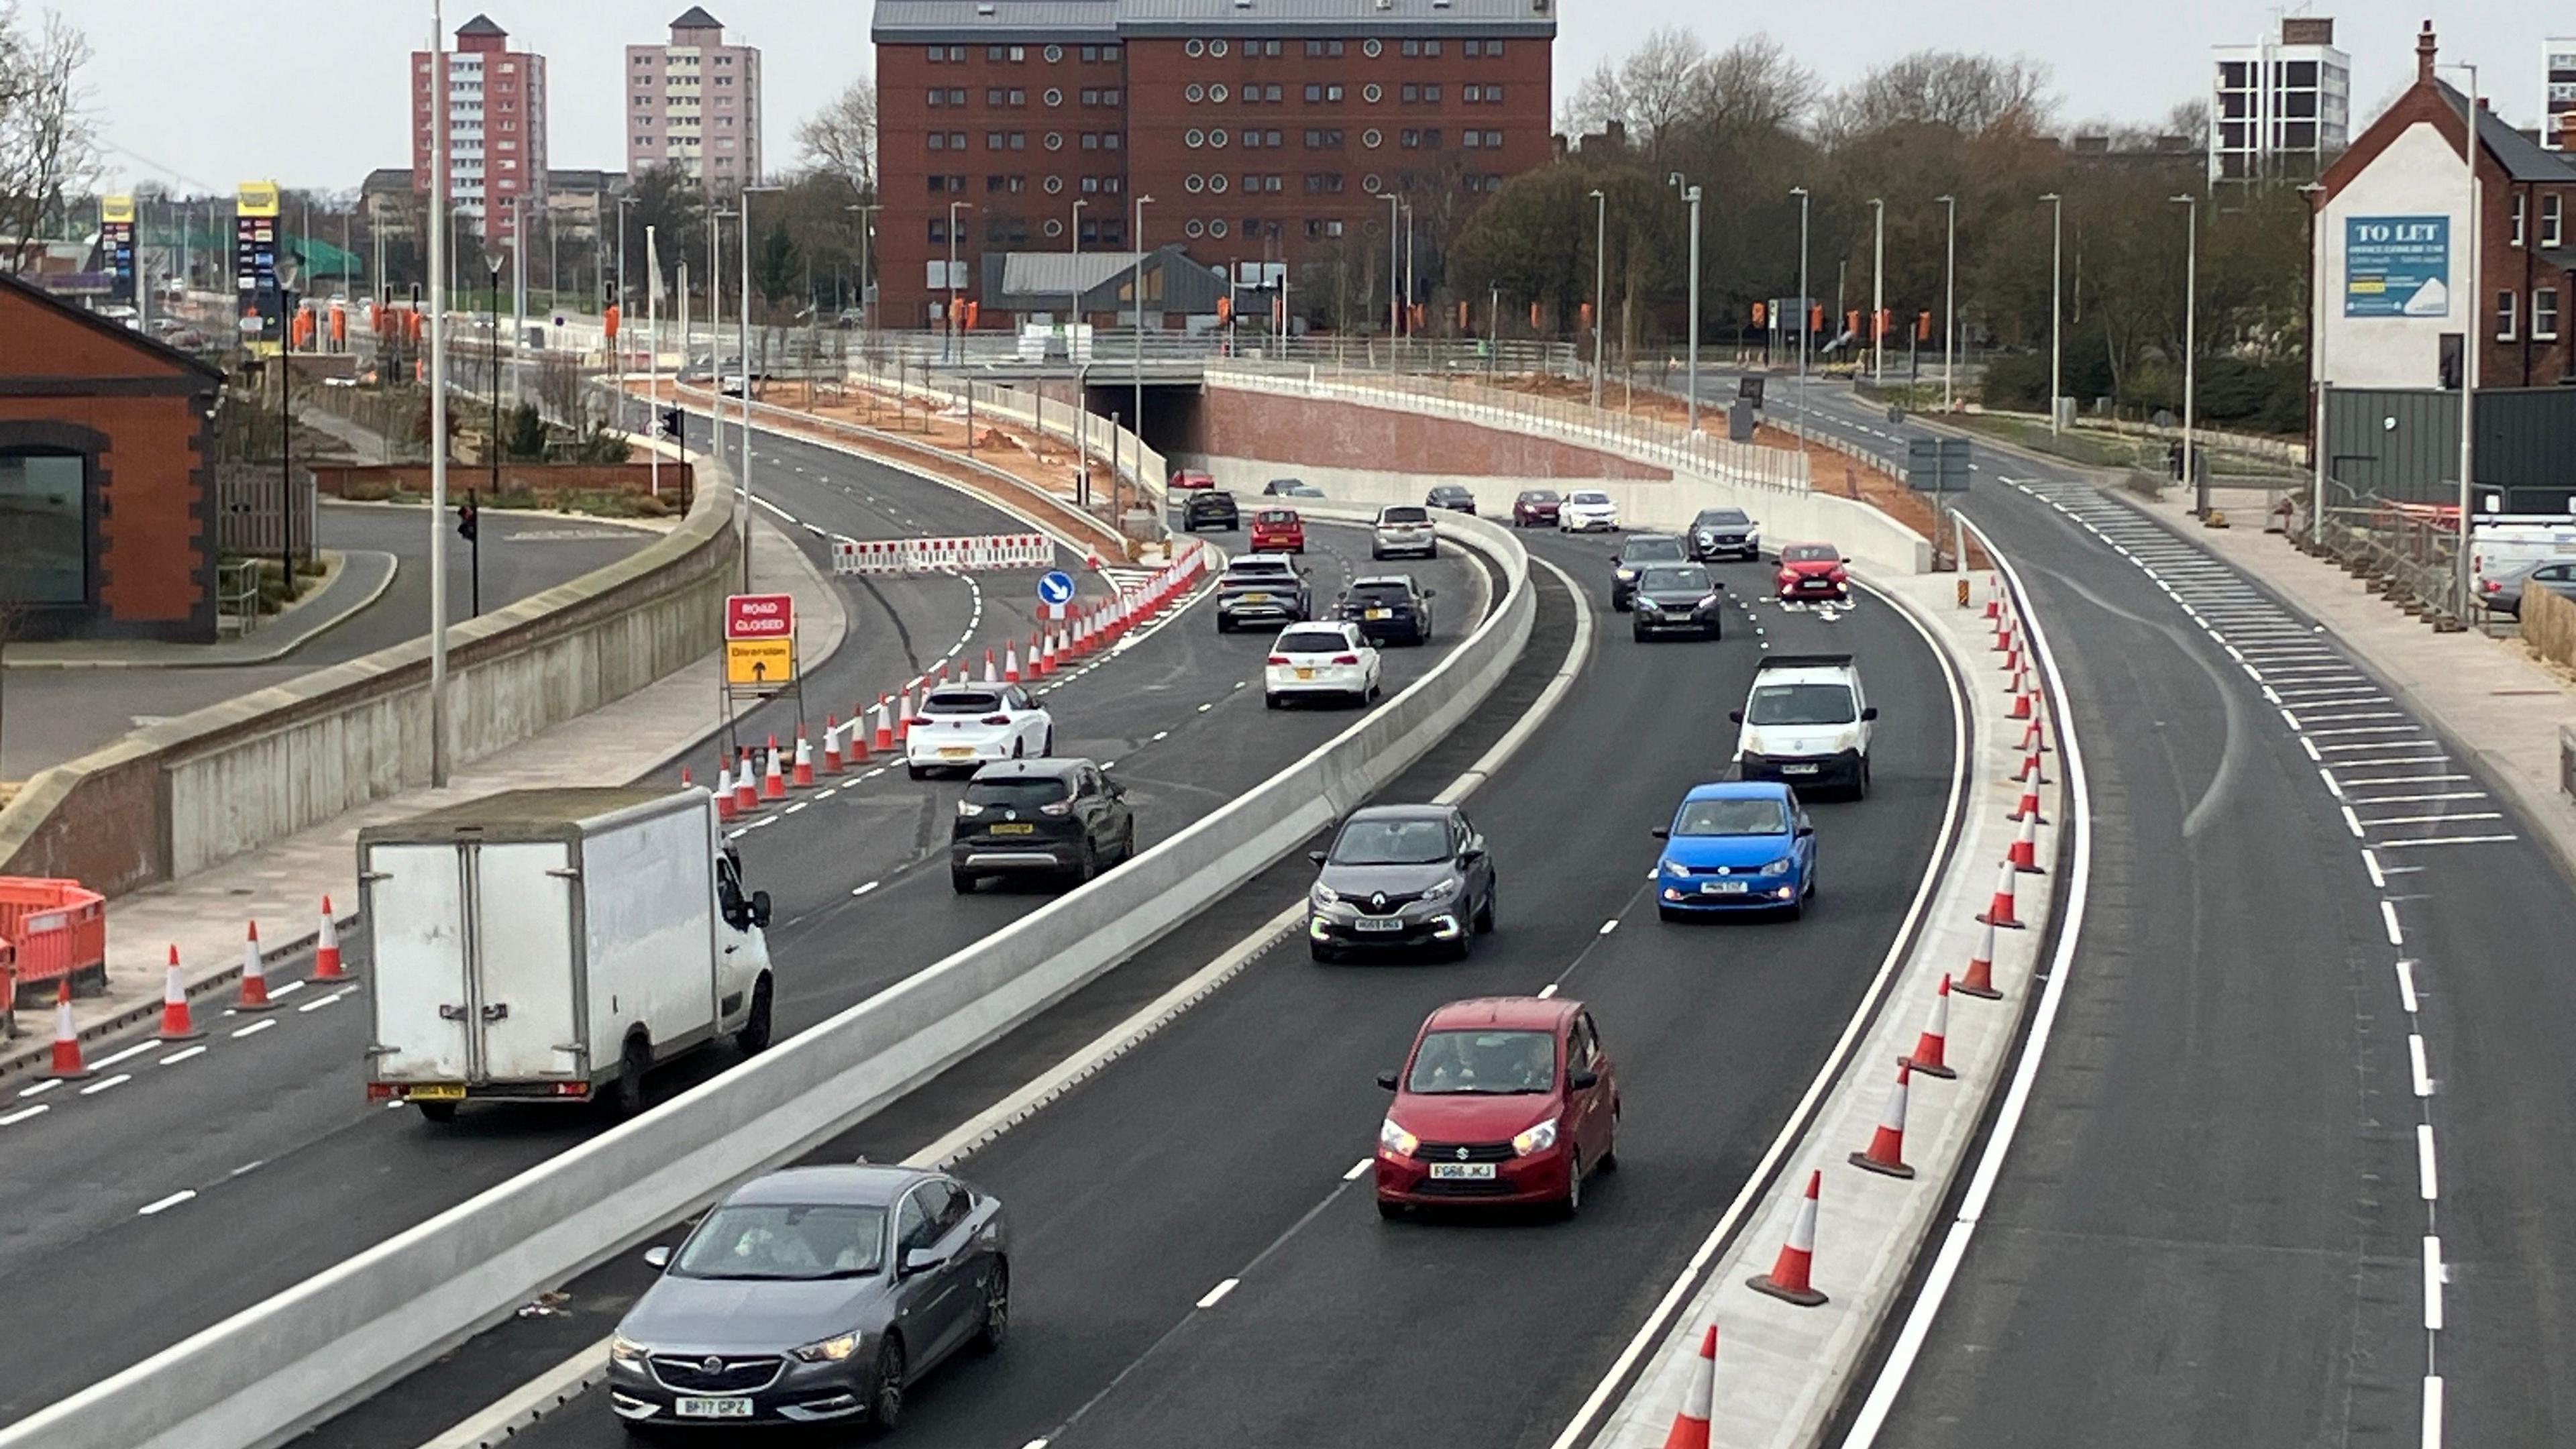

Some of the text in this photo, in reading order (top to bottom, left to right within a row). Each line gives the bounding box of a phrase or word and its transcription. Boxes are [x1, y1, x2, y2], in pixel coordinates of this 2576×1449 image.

[2356, 223, 2438, 241] TO LET
[742, 602, 777, 614] ROAD
[735, 619, 784, 631] CLOSED
[731, 647, 786, 657] Diversion
